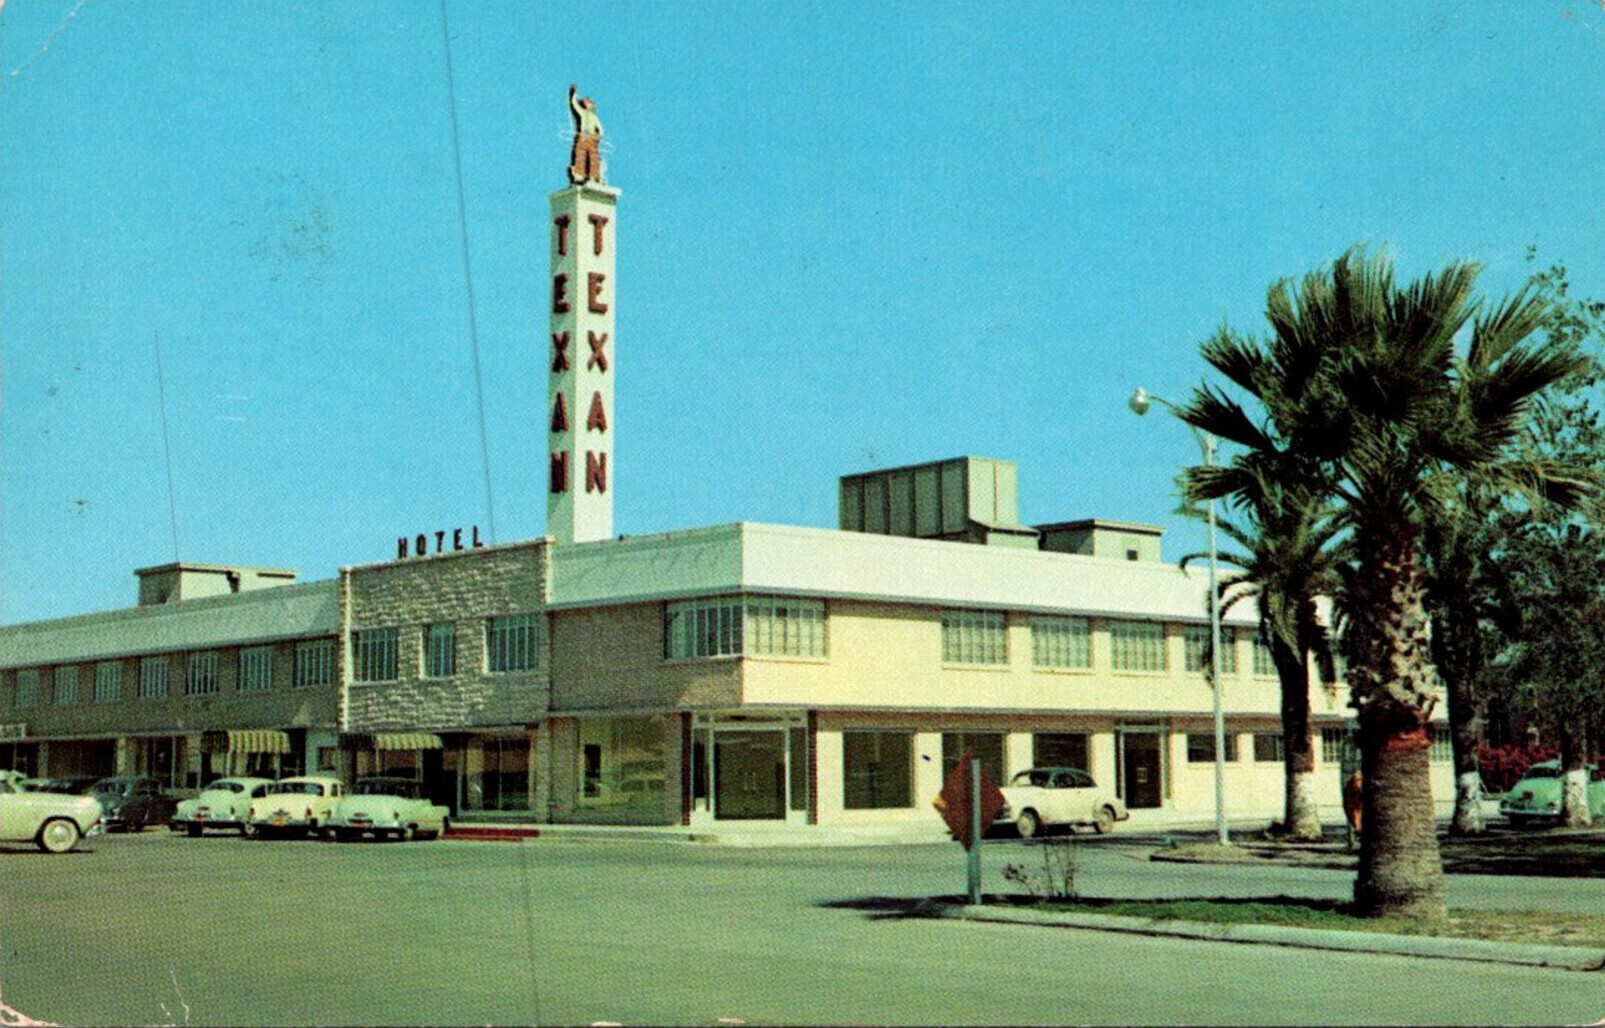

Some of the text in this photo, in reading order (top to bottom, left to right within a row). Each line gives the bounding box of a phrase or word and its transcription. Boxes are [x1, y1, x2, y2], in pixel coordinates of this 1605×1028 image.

[550, 214, 571, 494] TEXAN
[586, 213, 608, 494] TEXAN
[397, 525, 484, 559] HOTEL
